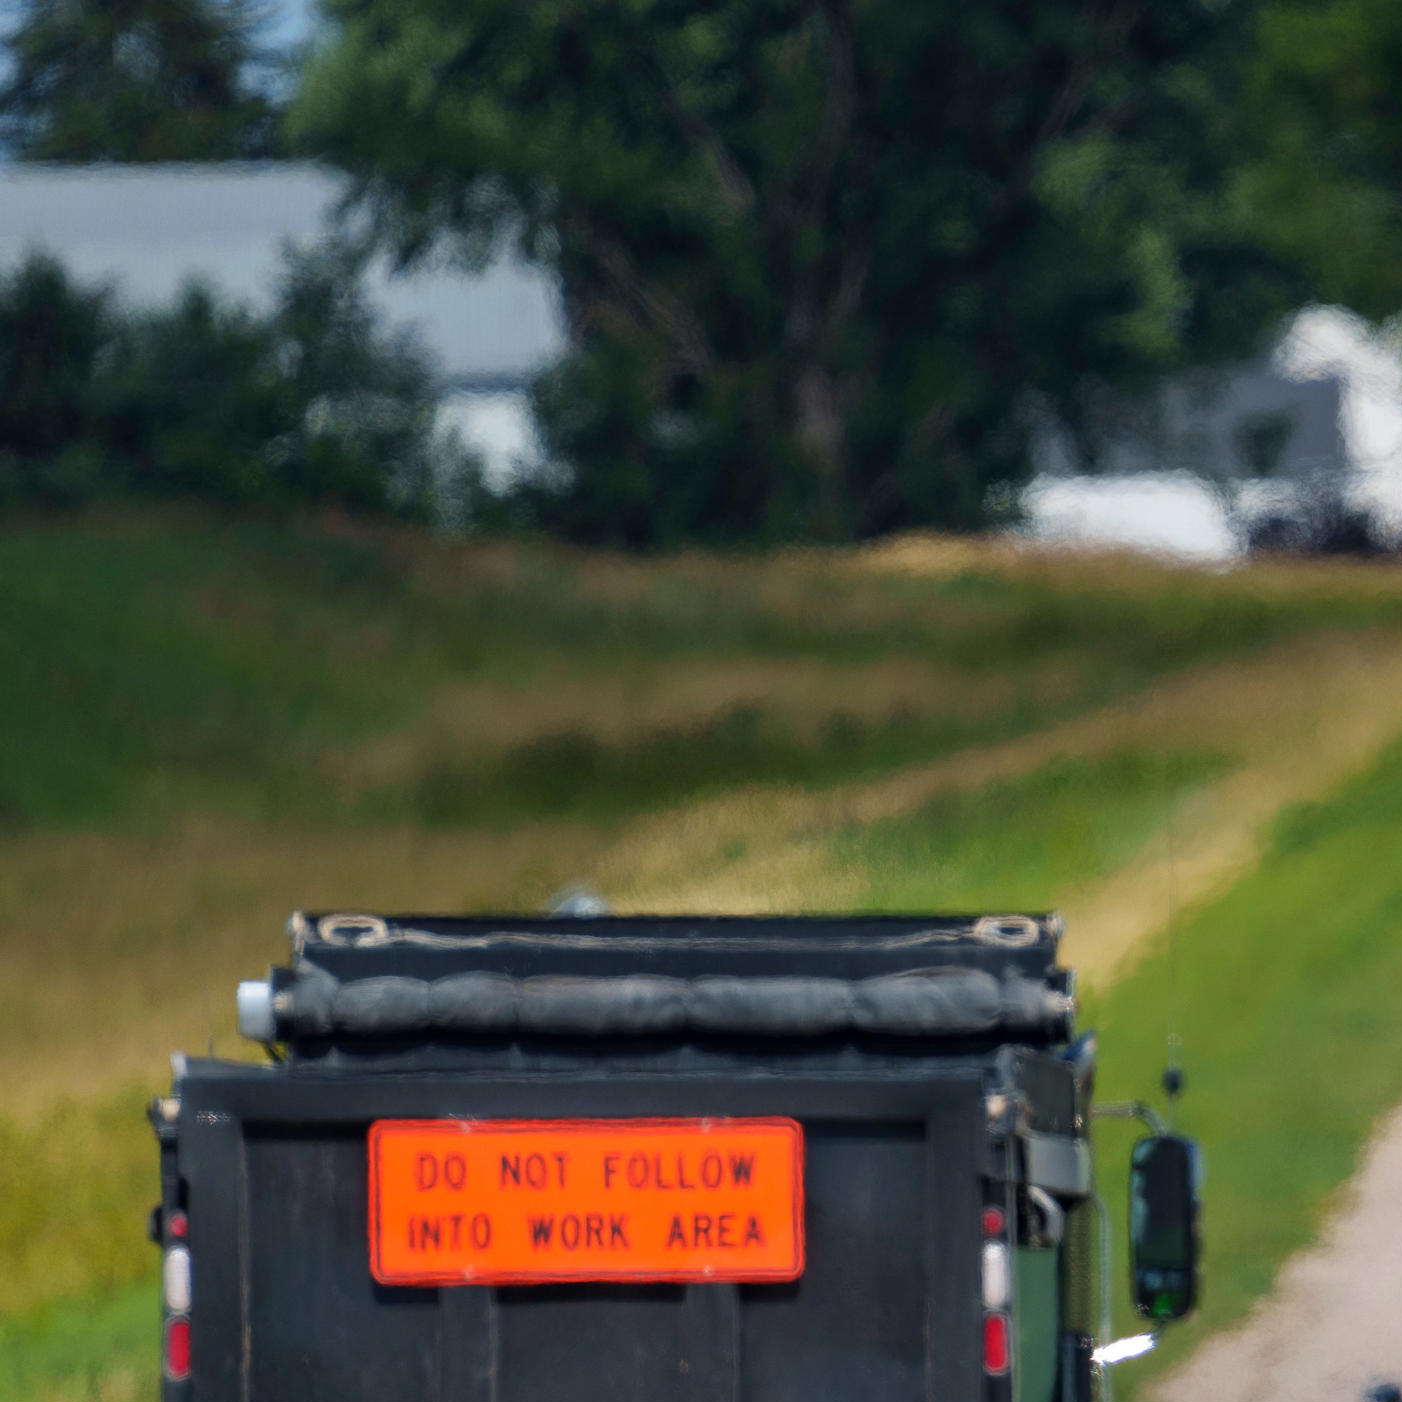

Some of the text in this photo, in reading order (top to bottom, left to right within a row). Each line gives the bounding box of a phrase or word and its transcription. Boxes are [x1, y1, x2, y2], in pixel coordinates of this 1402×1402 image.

[417, 1151, 755, 1190] DO NOT FOLLOW
[409, 1213, 763, 1250] INTO WORK AREA
